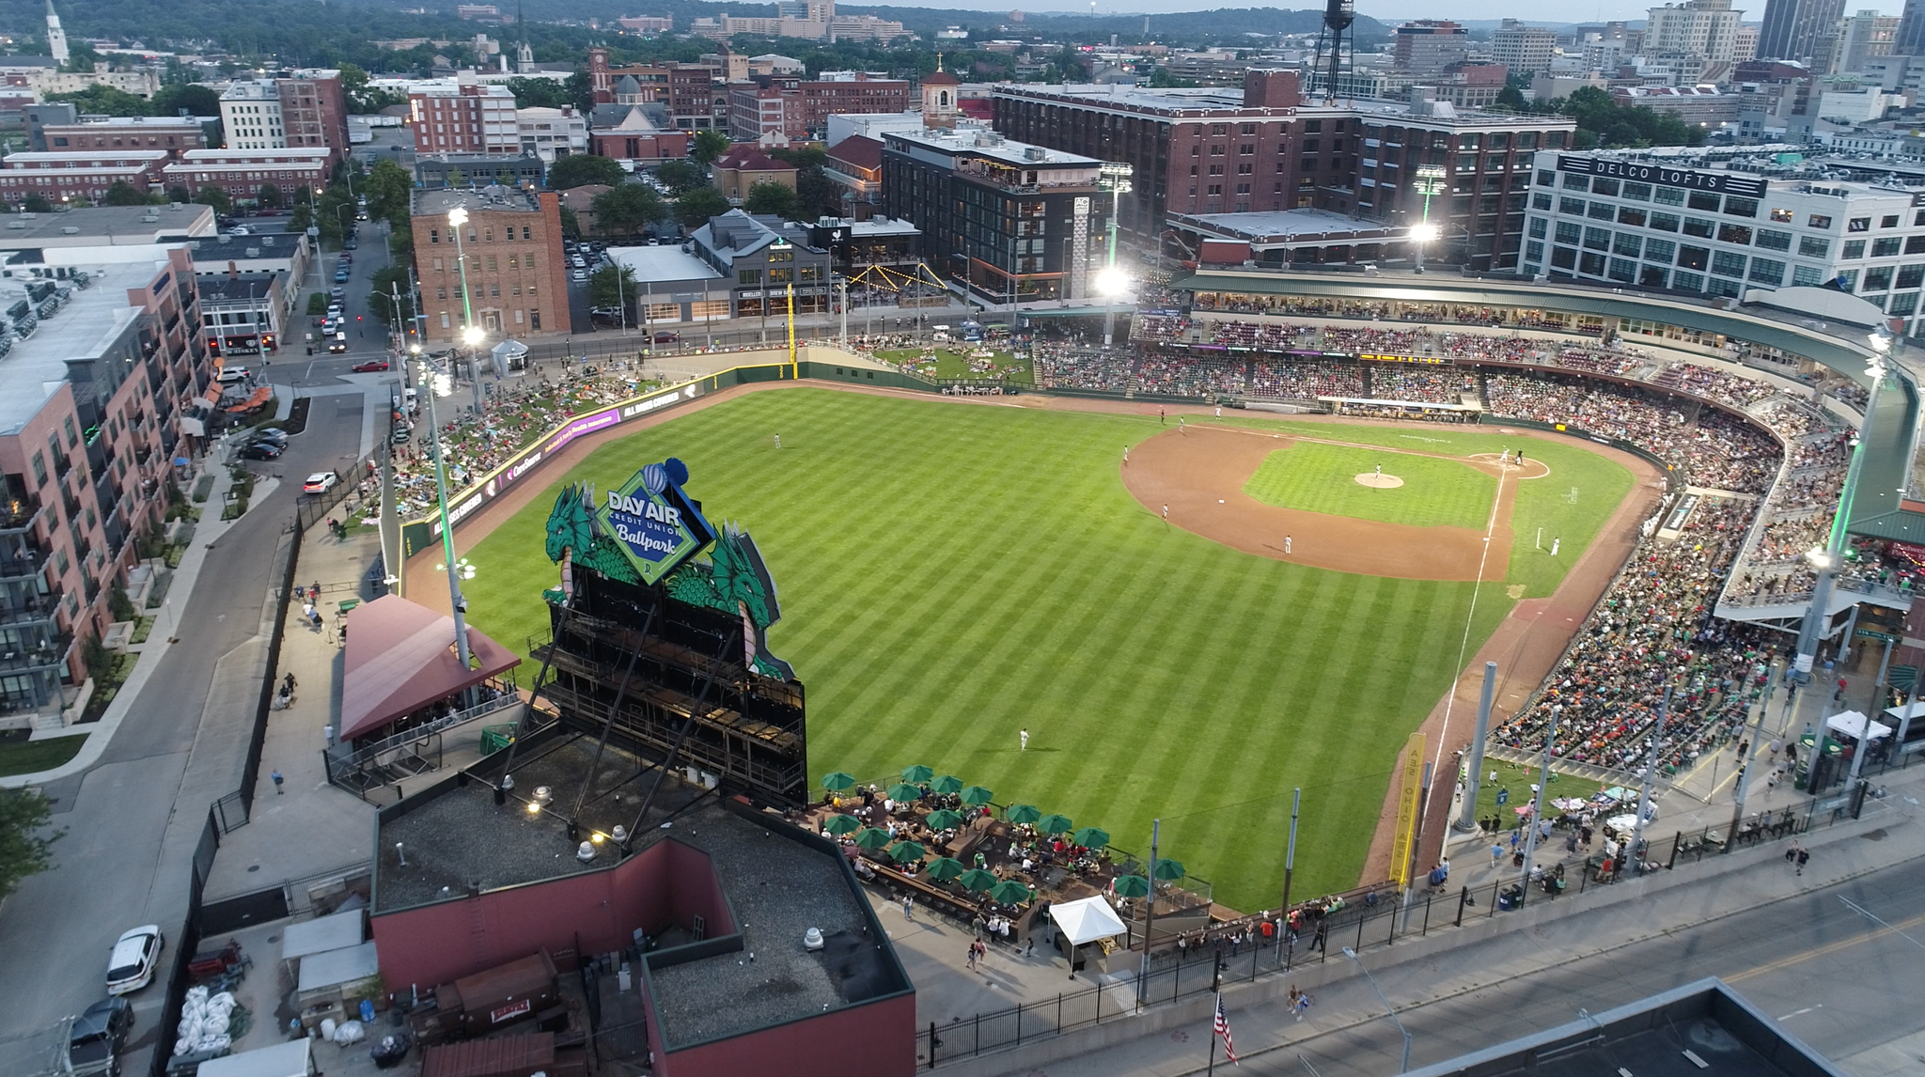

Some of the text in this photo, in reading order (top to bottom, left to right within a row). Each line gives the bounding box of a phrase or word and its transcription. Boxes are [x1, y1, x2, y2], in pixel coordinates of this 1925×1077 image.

[1597, 161, 1717, 188] DELCO LOFTS
[1076, 198, 1089, 206] AC
[624, 406, 636, 418] ALL
[513, 452, 542, 478] CareSource
[608, 491, 681, 527] DAY AIR
[609, 512, 683, 537] CREDIT UNION
[616, 523, 677, 555] Ballpark
